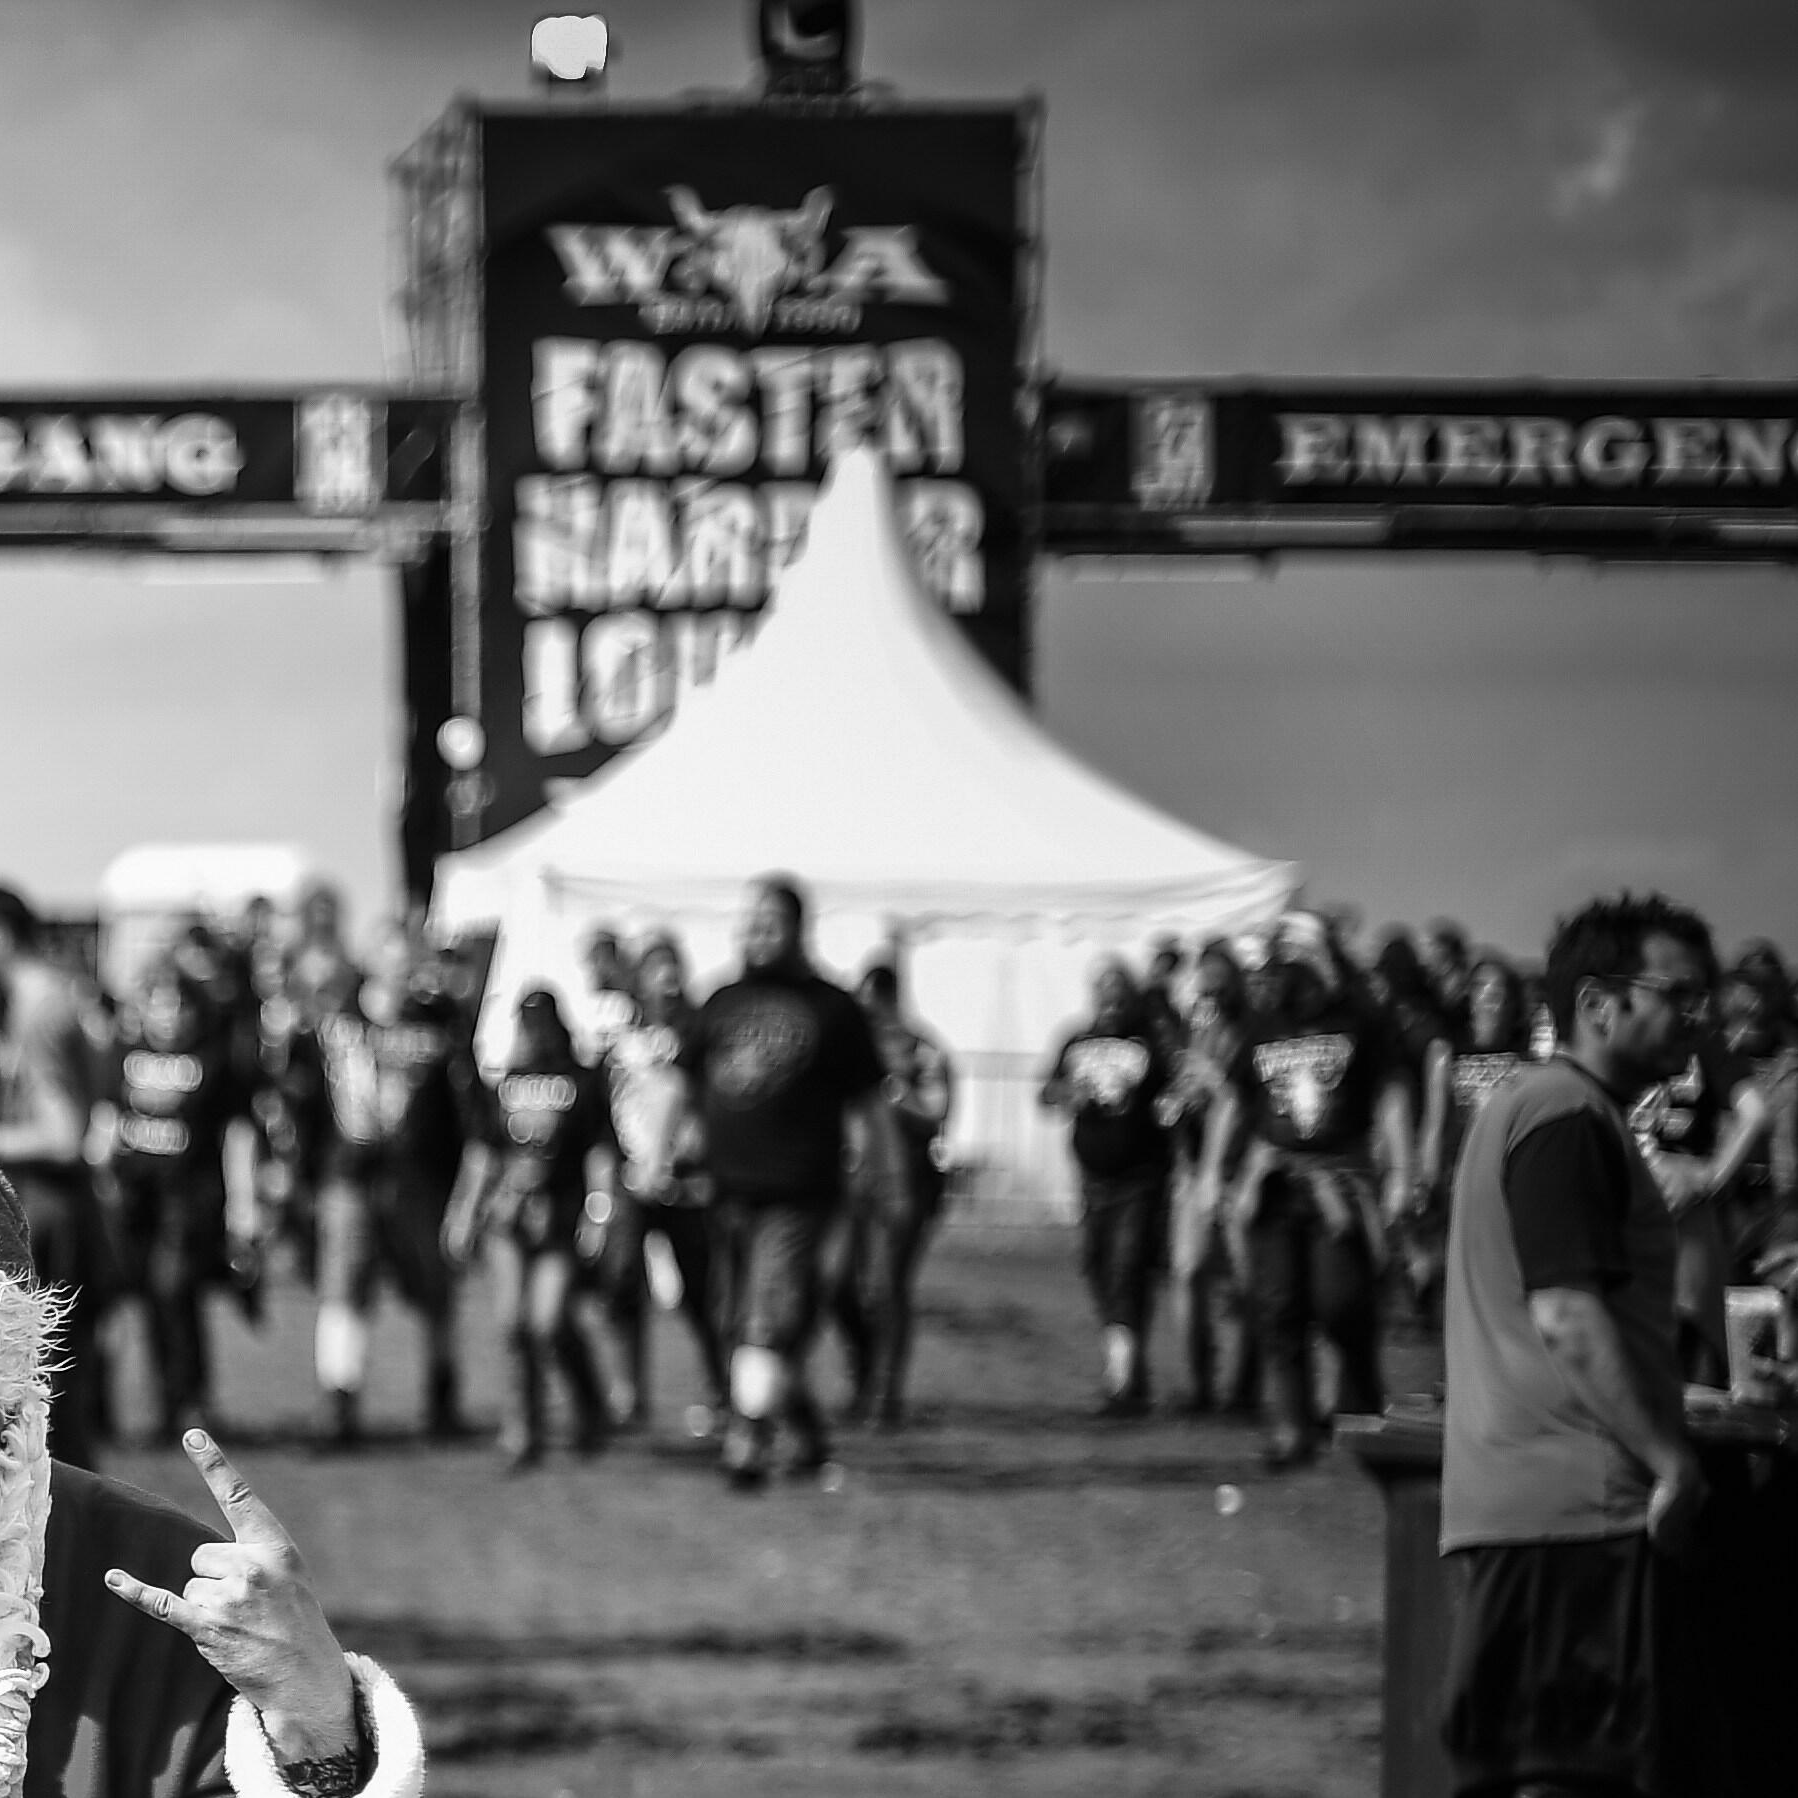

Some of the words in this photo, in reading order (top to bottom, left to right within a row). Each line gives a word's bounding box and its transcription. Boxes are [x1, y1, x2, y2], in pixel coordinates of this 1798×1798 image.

[530, 335, 965, 477] FASTER
[1272, 411, 1798, 490] EMERGEN
[511, 471, 986, 616] HARR
